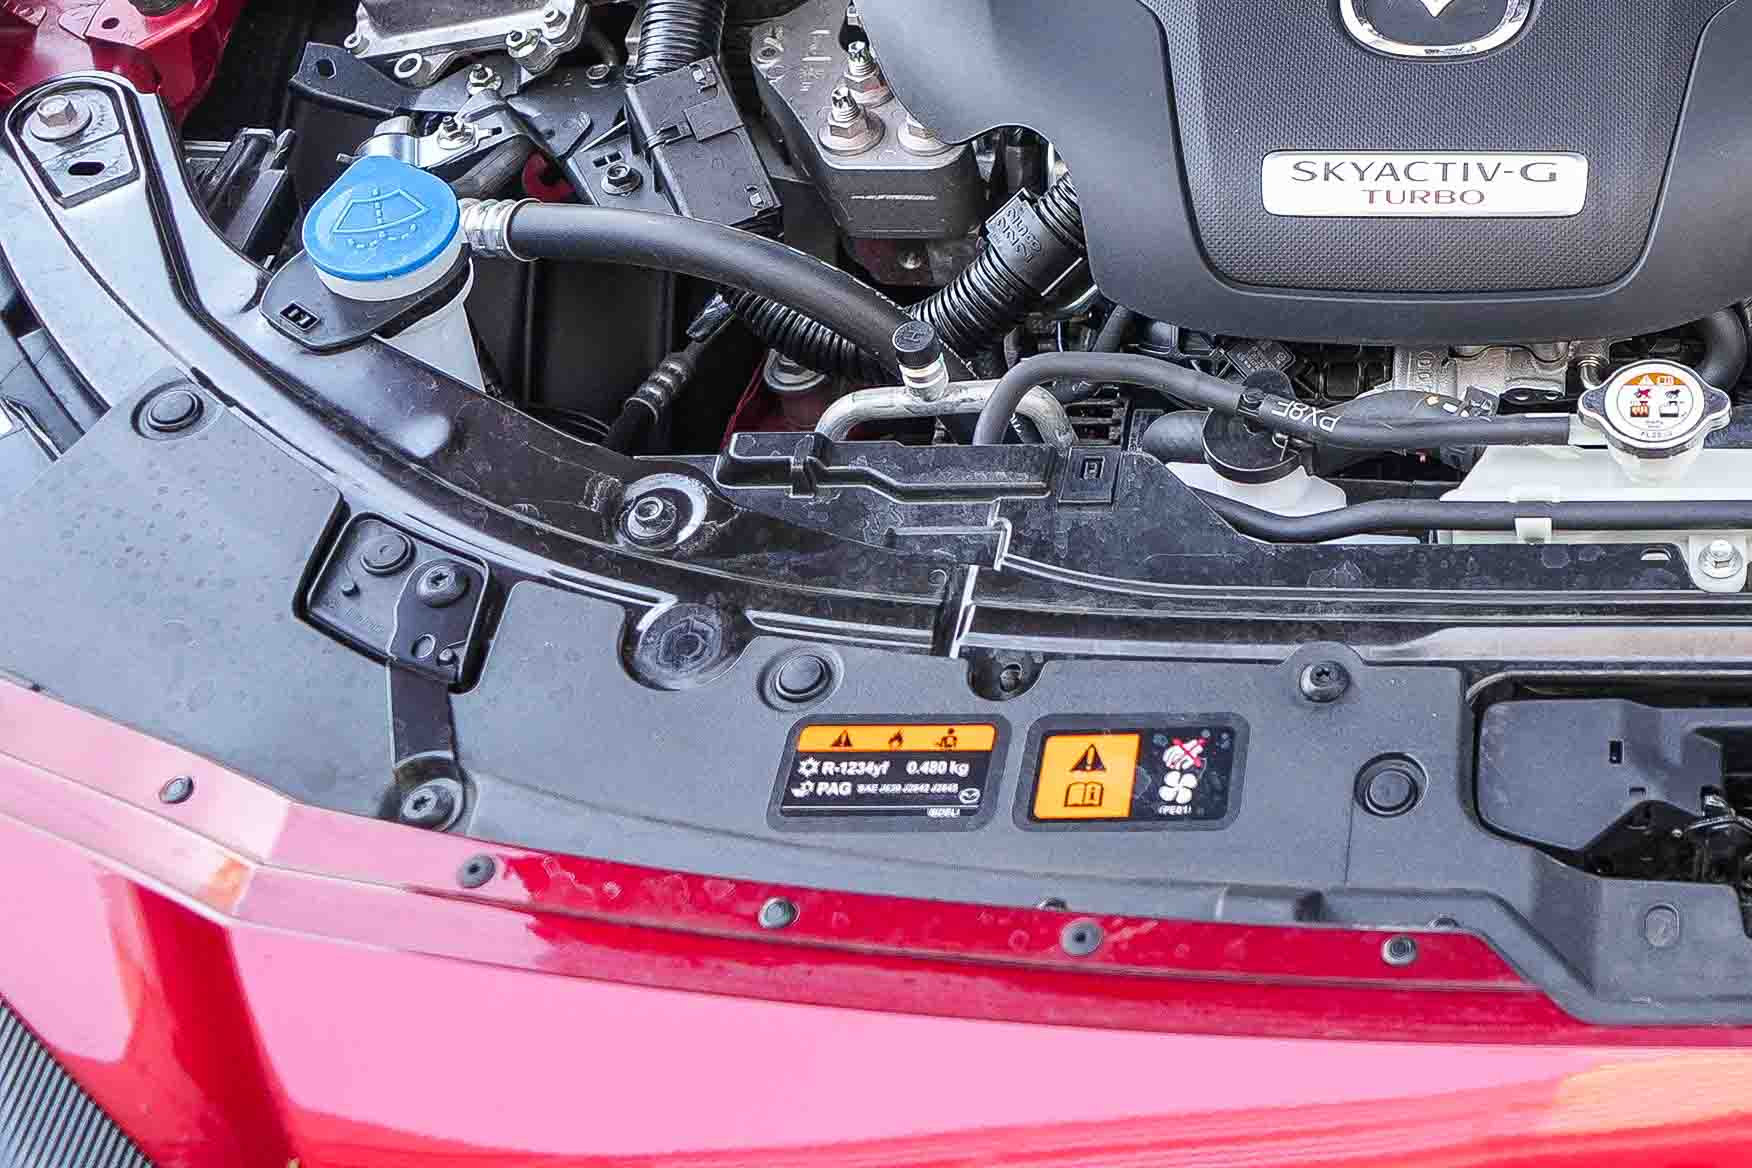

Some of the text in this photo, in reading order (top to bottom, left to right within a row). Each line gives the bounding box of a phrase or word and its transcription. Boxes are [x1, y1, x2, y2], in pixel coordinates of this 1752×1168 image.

[1290, 160, 1558, 183] SKYACTIV-G
[1360, 188, 1487, 205] TURBO
[1271, 400, 1343, 433] PX8F
[821, 760, 891, 778] R-1234yf
[949, 760, 970, 778] kg
[816, 782, 852, 797] PAG
